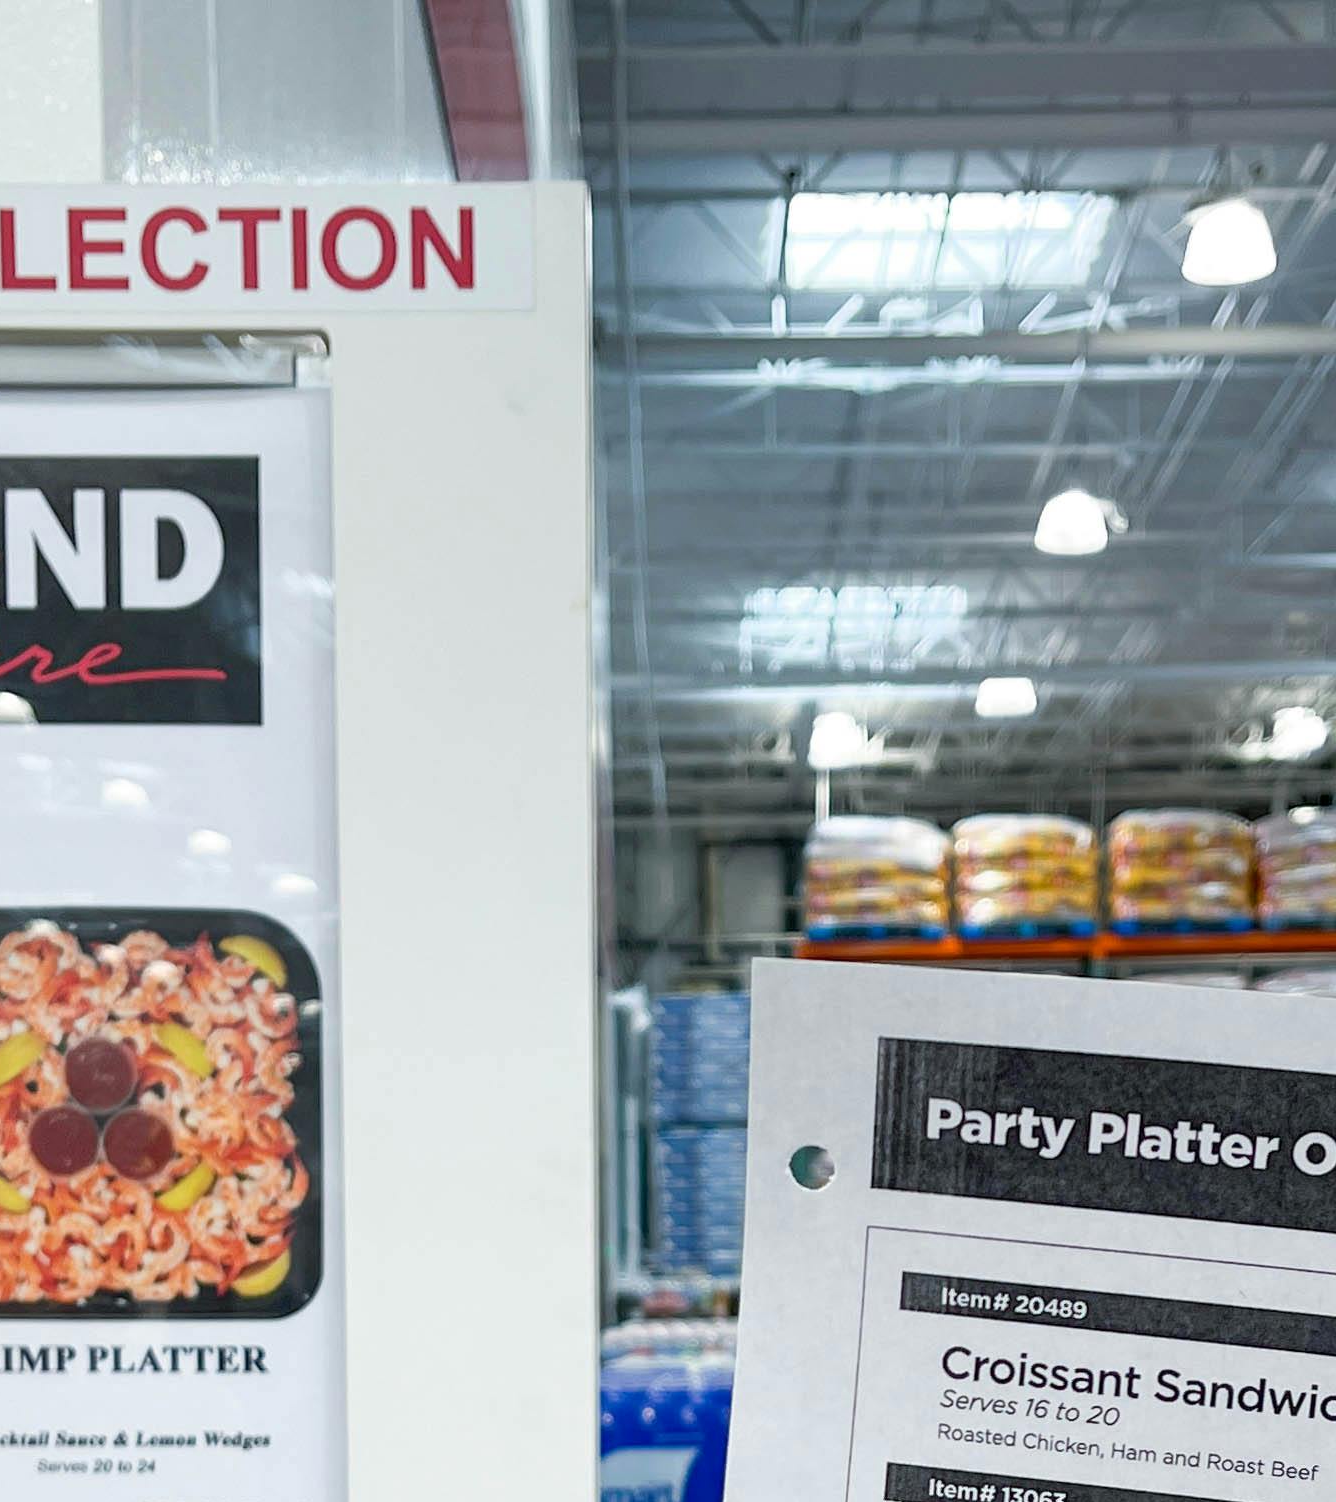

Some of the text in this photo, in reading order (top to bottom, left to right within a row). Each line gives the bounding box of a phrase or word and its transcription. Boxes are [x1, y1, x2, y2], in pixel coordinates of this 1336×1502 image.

[926, 1098, 1075, 1160] Party
[1088, 1112, 1279, 1170] Platter
[941, 1287, 1089, 1320] Item# 20489
[88, 1345, 269, 1374] PLATTER
[941, 1345, 1140, 1399] Croissant
[940, 1389, 1121, 1427] Serves 16 to 20
[56, 1431, 107, 1448] Sauce
[114, 1432, 128, 1448] &
[136, 1431, 196, 1448] Lemon
[204, 1431, 270, 1451] Wedges
[937, 1424, 1320, 1481] Roasted Chicken, Ham and Roast Beef
[928, 1478, 996, 1502] Item#
